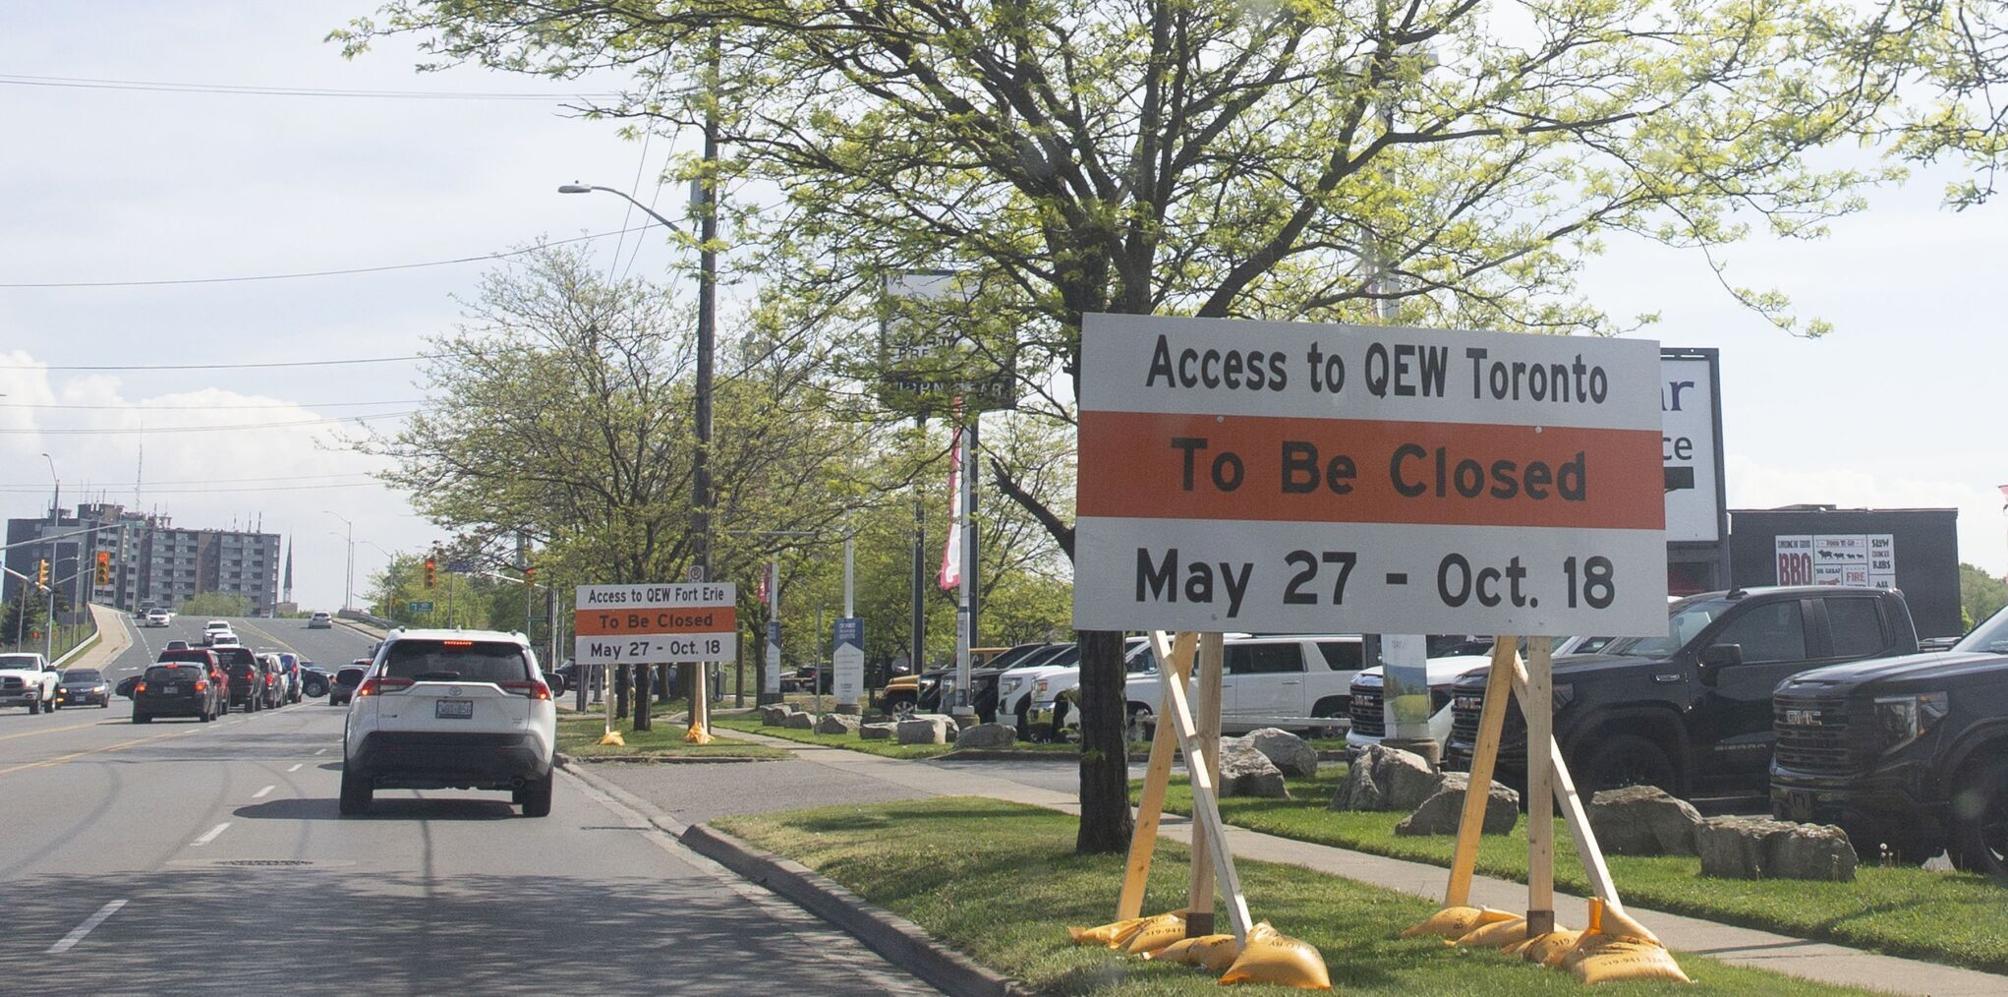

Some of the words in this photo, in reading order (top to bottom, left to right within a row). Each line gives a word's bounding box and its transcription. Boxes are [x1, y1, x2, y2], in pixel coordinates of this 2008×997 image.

[1146, 334, 1288, 392] Access
[1308, 341, 1345, 394] to
[1364, 342, 1449, 399] QEW
[1466, 347, 1608, 405] Toronto
[1171, 437, 1245, 493] To
[1281, 441, 1357, 495] Be
[1390, 443, 1587, 502] Closed
[1778, 553, 1813, 586] BBQ
[588, 589, 626, 603] Access
[631, 589, 642, 603] to
[647, 588, 671, 602] QEW
[675, 588, 698, 601] Fort
[703, 587, 724, 601] Erie
[1136, 548, 1254, 618] May
[1283, 551, 1357, 605] 27
[1386, 572, 1408, 586] -
[1437, 553, 1538, 608] Oct.
[1564, 555, 1615, 609] 18
[599, 615, 619, 629] To
[628, 615, 649, 628] Be
[657, 613, 713, 627] Closed
[590, 643, 622, 660] May
[629, 642, 650, 656] 27
[670, 641, 698, 655] Oct.
[706, 640, 720, 654] 18
[1786, 710, 1822, 726] GMC
